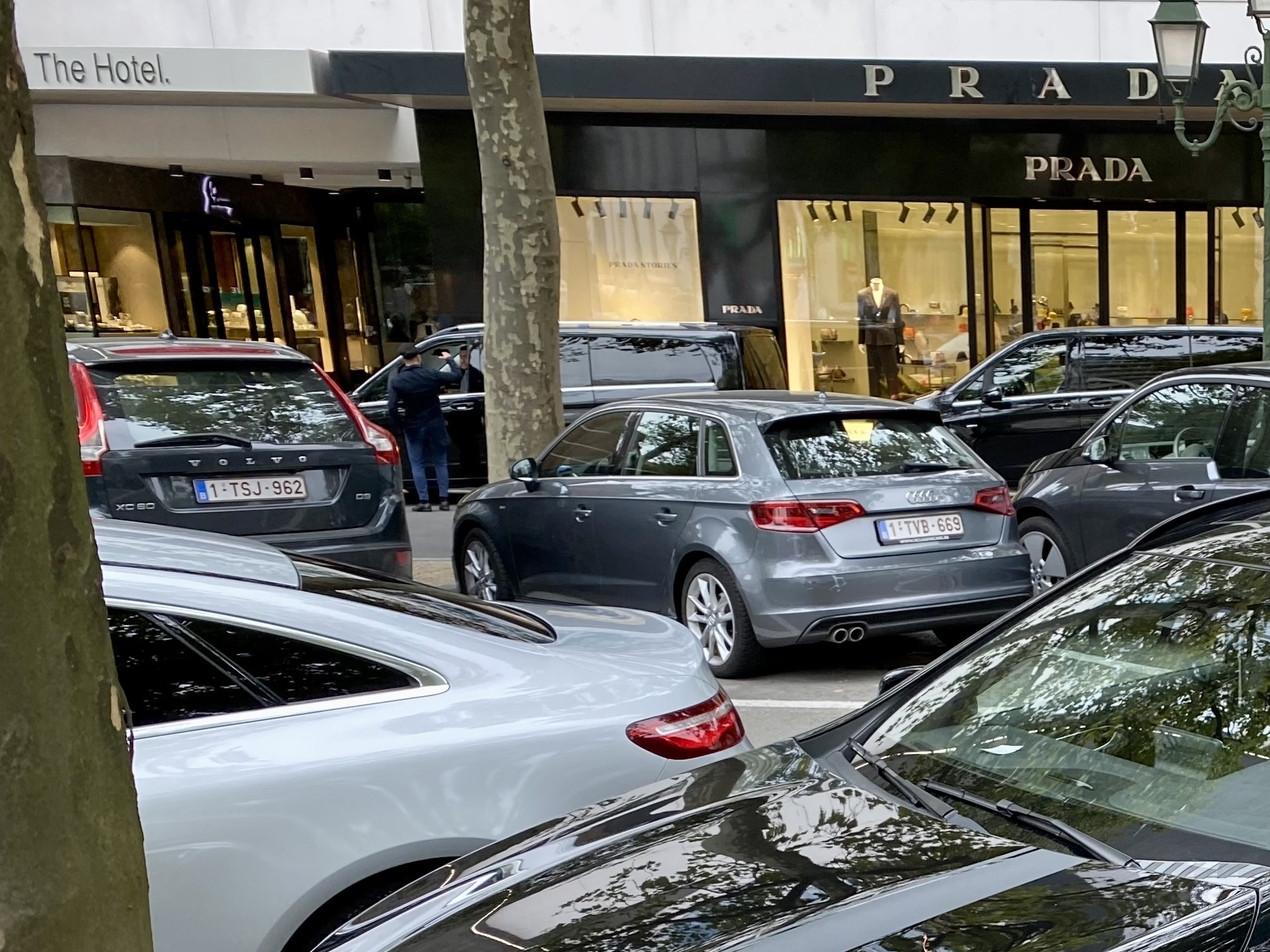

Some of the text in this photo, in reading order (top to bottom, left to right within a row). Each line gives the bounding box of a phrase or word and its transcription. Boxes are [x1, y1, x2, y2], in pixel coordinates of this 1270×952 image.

[33, 53, 171, 84] The Hotel.
[862, 64, 1246, 101] PRADA
[1024, 156, 1154, 182] PRADA
[608, 261, 639, 269] PRADA
[721, 305, 763, 314] PRADA
[188, 455, 307, 467] VOLVO
[209, 479, 303, 498] 1-TSJ-962
[888, 516, 961, 537] 1-TVB-669
